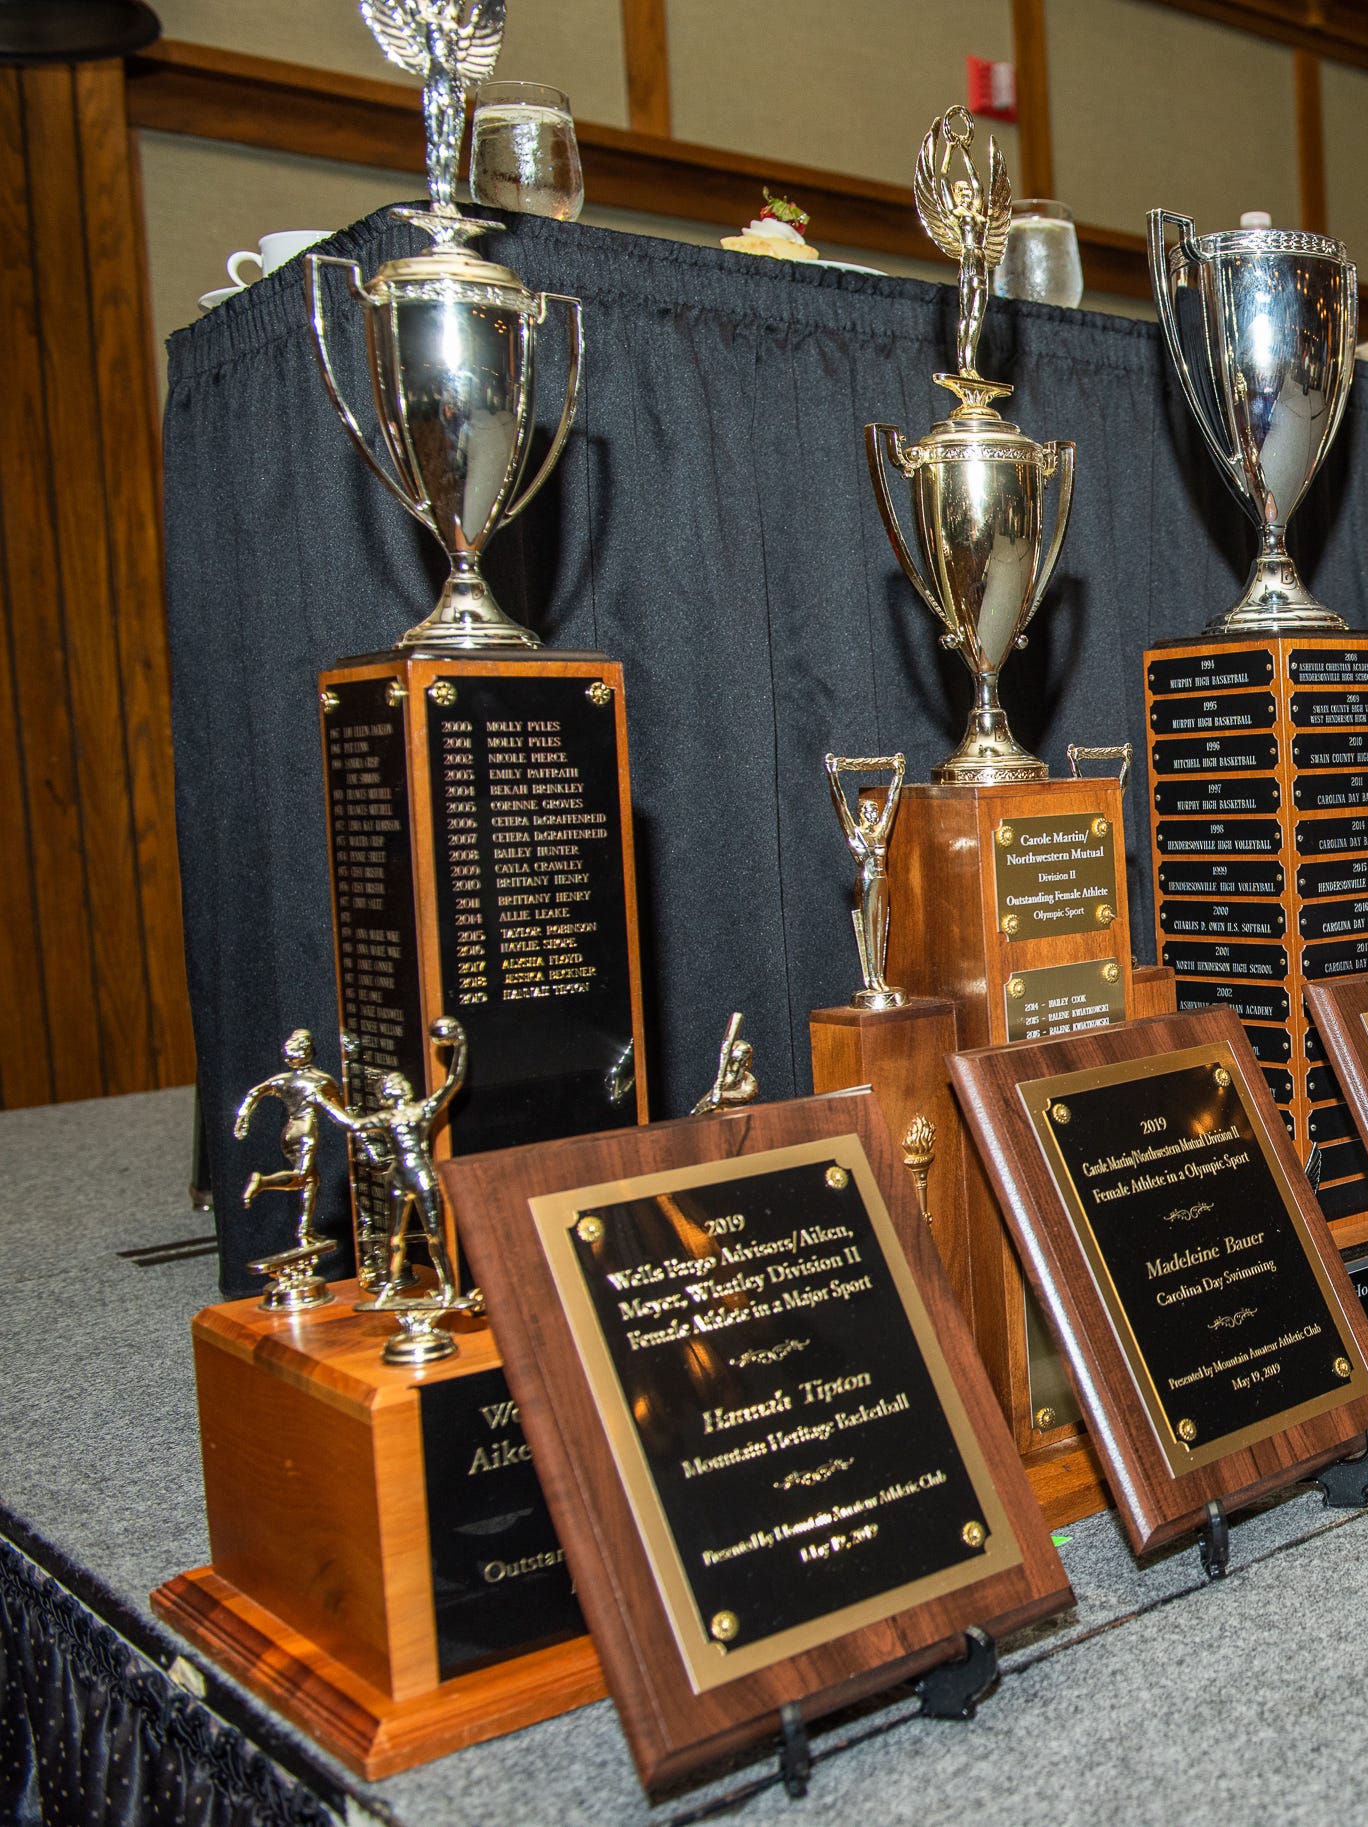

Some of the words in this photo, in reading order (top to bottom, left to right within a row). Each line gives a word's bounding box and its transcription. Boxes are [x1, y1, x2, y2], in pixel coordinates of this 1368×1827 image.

[1201, 660, 1215, 670] 1994
[1170, 678, 1192, 688] MURPHY
[1195, 676, 1210, 687] HIGH
[1212, 673, 1249, 684] BASKETBALL
[1203, 701, 1217, 711] 1995
[441, 721, 472, 733] 2000
[486, 721, 523, 732] MOLLY
[527, 721, 561, 732] PYLES
[1172, 718, 1195, 729] MURPHY
[1197, 717, 1212, 728] HIGH
[1214, 715, 1252, 727] BASKETBALL
[1206, 741, 1220, 751] 1996
[1349, 737, 1362, 746] 2010
[443, 754, 474, 765] 2002
[488, 753, 527, 764] NICOLE
[531, 752, 568, 763] PIERCE
[1173, 759, 1200, 769] MITCHELL
[1202, 758, 1217, 767] HIGH
[1219, 755, 1257, 767] BASKETBALL
[1310, 754, 1330, 764] SWAIN
[1332, 754, 1354, 763] COUNTY
[444, 770, 475, 781] 2003
[489, 769, 522, 780] EMILY
[527, 768, 579, 779] PAFFRATH
[1351, 777, 1363, 786] 2011
[1317, 794, 1346, 805] CAROLINA
[1348, 793, 1360, 803] DAY
[1210, 824, 1224, 834] 1998
[1352, 821, 1365, 830] 2014
[1020, 832, 1051, 847] Carole
[1053, 829, 1089, 844] Martin/
[1167, 840, 1216, 850] HENDERSONVILLE
[1217, 840, 1232, 850] HIGH
[1234, 840, 1272, 850] VOLLEYBALL
[1319, 838, 1347, 850] CAROLINA
[1350, 837, 1361, 847] DAY
[1006, 852, 1070, 866] Northwestern
[1071, 847, 1104, 859] Mutual
[450, 865, 481, 877] 2009
[495, 863, 530, 875] CAYLA
[534, 860, 584, 872] CRAWLEY
[1353, 863, 1367, 872] 2015
[452, 880, 481, 891] 2010
[496, 876, 549, 888] BRITTANY
[554, 873, 590, 885] HENRY
[1038, 872, 1067, 883] Division
[1069, 870, 1076, 880] II
[1318, 878, 1366, 893] HENDERSONVILLE
[1006, 891, 1054, 906] Outstanding
[1055, 888, 1081, 901] Female
[1082, 886, 1108, 898] Athlete
[455, 914, 483, 925] 2014
[499, 910, 531, 922] ALLIE
[535, 908, 571, 919] LEAKE
[1033, 909, 1063, 921] Olympic
[1065, 907, 1084, 918] Sport
[1213, 906, 1229, 916] 2000
[1173, 921, 1199, 930] CHARLES
[1201, 922, 1207, 931] D.
[1208, 922, 1225, 932] OWEN
[1227, 923, 1240, 932] H.S.
[1241, 923, 1271, 933] SOFTBALL
[1215, 946, 1230, 956] 2001
[1176, 961, 1195, 970] NORTH
[1197, 962, 1230, 972] HENDERSON
[1232, 963, 1248, 973] HIGH
[1249, 964, 1272, 974] SCHOOL
[1071, 994, 1087, 1004] COOK
[1216, 987, 1233, 997] 2002
[1245, 1003, 1273, 1016] ACADEMY
[1140, 1116, 1167, 1135] 2019
[1082, 1156, 1110, 1178] Carole
[1106, 1143, 1181, 1174] Martin/Northwestern
[1179, 1134, 1206, 1153] Mutual
[1203, 1128, 1232, 1147] Division
[1231, 1125, 1240, 1139] II
[1093, 1183, 1131, 1204] Female
[1131, 1174, 1166, 1194] Athlete
[1166, 1169, 1178, 1182] in
[1178, 1171, 1186, 1180] a
[1184, 1157, 1225, 1180] Olympic
[1224, 1151, 1250, 1171] Sport
[704, 1214, 746, 1237] 2019
[720, 1224, 854, 1266] Advisors/Aiken,
[1145, 1246, 1220, 1279] Madeleine
[1224, 1232, 1265, 1255] Bauer
[766, 1255, 842, 1283] Division
[842, 1245, 862, 1265] II
[1156, 1283, 1202, 1306] Carolina
[1202, 1275, 1224, 1292] Day
[1223, 1259, 1277, 1284] Swimming
[750, 1299, 772, 1319] in
[771, 1300, 783, 1314] a
[782, 1287, 830, 1312] Major
[829, 1274, 873, 1301] Sport
[1168, 1366, 1203, 1390] Presented
[1202, 1362, 1214, 1378] by
[1212, 1351, 1249, 1374] Mountain
[1249, 1341, 1278, 1359] Amateur
[1278, 1330, 1305, 1348] Athletic
[1303, 1323, 1322, 1337] Club
[1231, 1375, 1250, 1391] May
[1250, 1371, 1264, 1383] 19,
[1263, 1362, 1281, 1378] 2019
[799, 1372, 872, 1404] Tipton
[835, 1392, 910, 1431] Basketball
[879, 1479, 921, 1504] Athletic
[919, 1469, 947, 1490] Club
